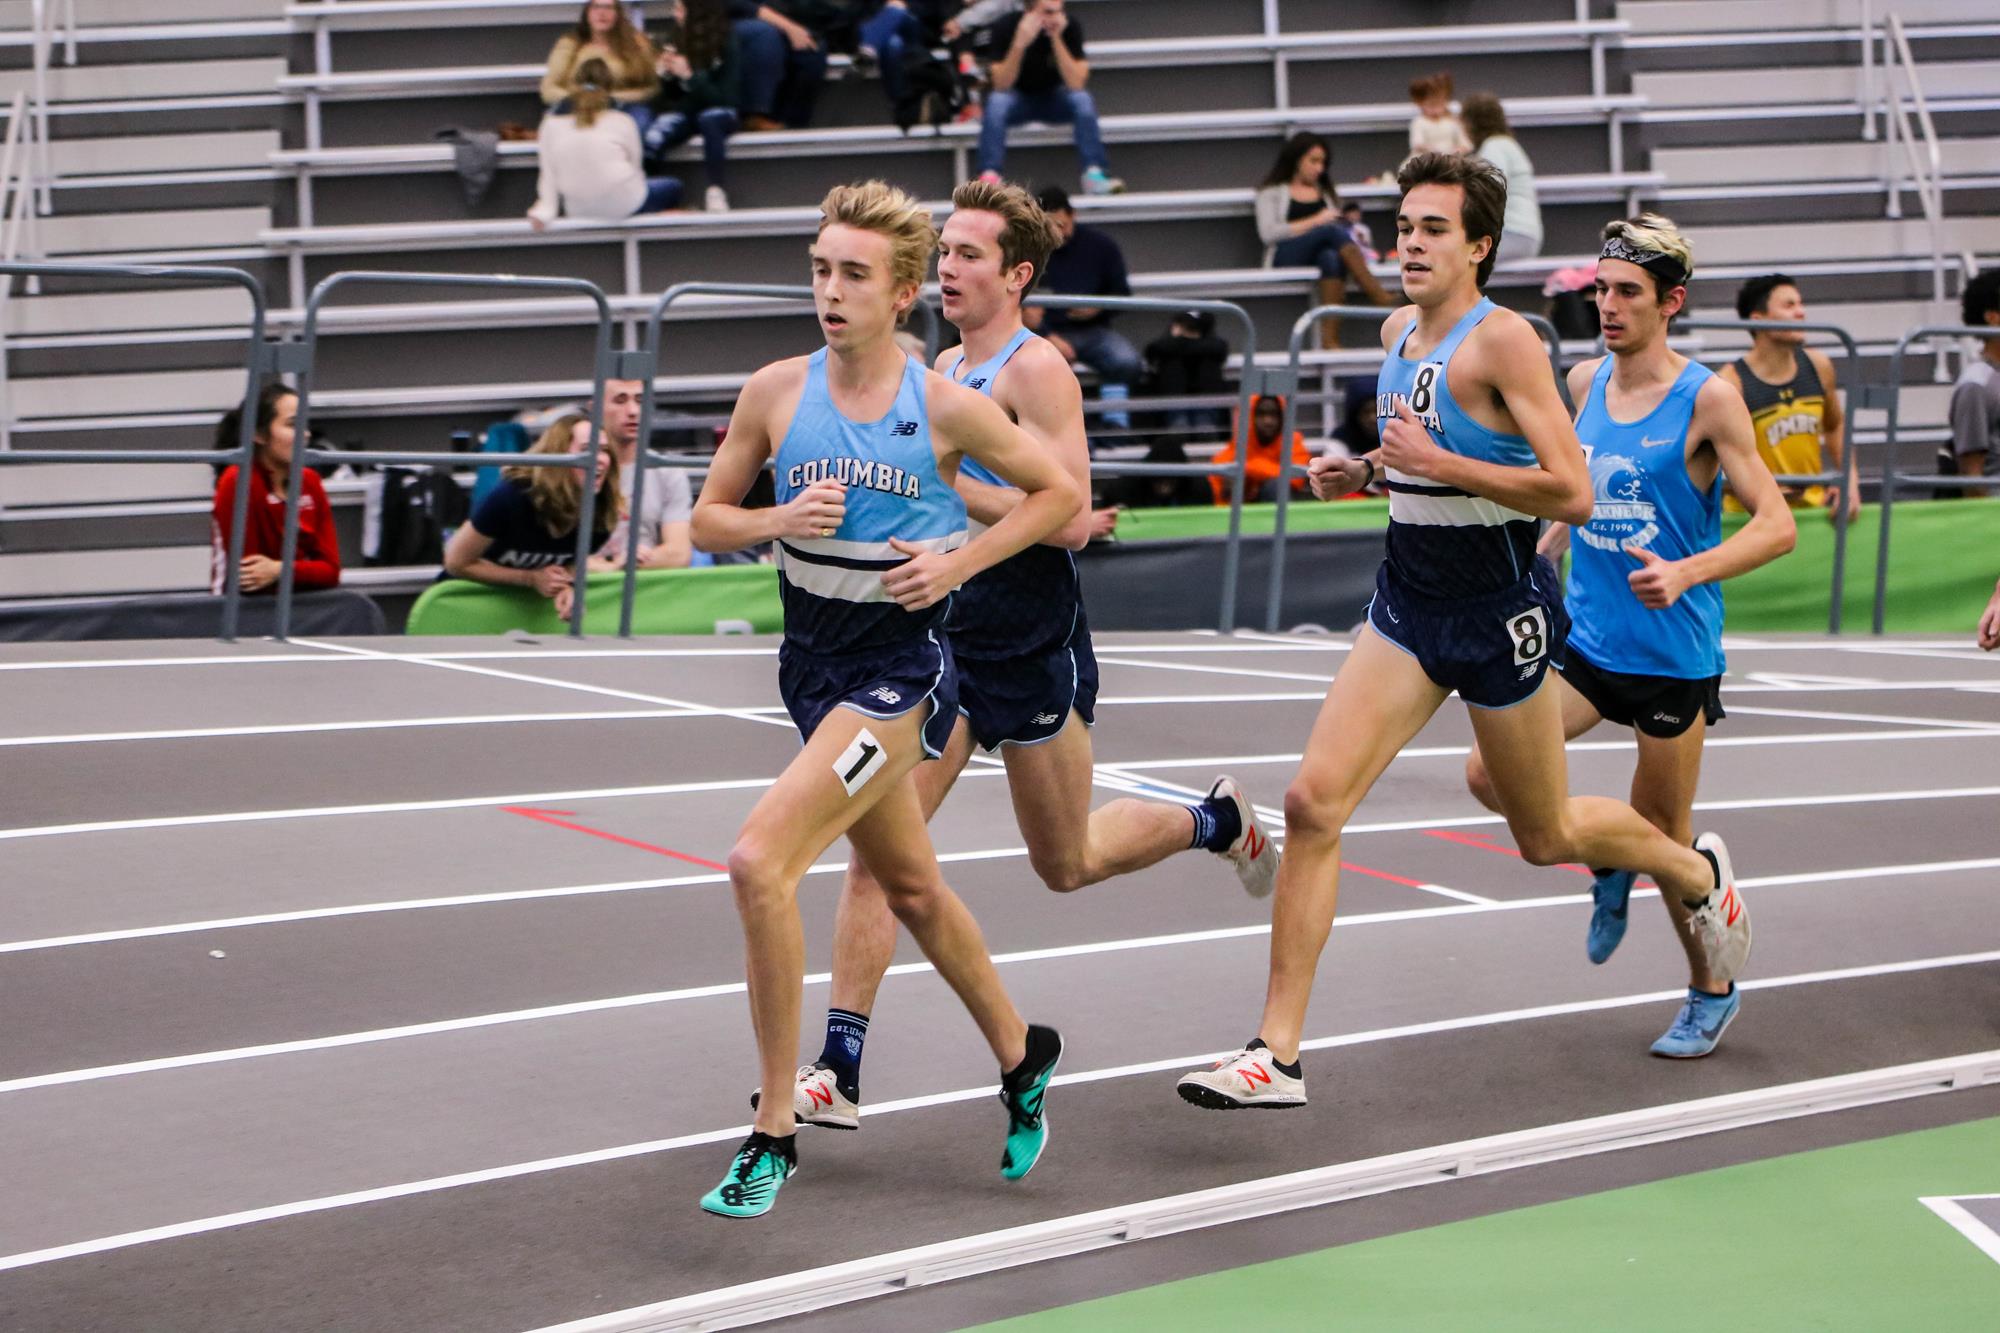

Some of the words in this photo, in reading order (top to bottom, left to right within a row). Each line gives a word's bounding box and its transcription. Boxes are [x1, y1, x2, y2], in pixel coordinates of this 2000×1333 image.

[1412, 367, 1435, 414] 8
[787, 456, 922, 499] COLUMBIA
[1513, 615, 1543, 660] 8
[843, 740, 880, 786] 1
[804, 1081, 834, 1112] N
[1236, 1062, 1272, 1091] N
